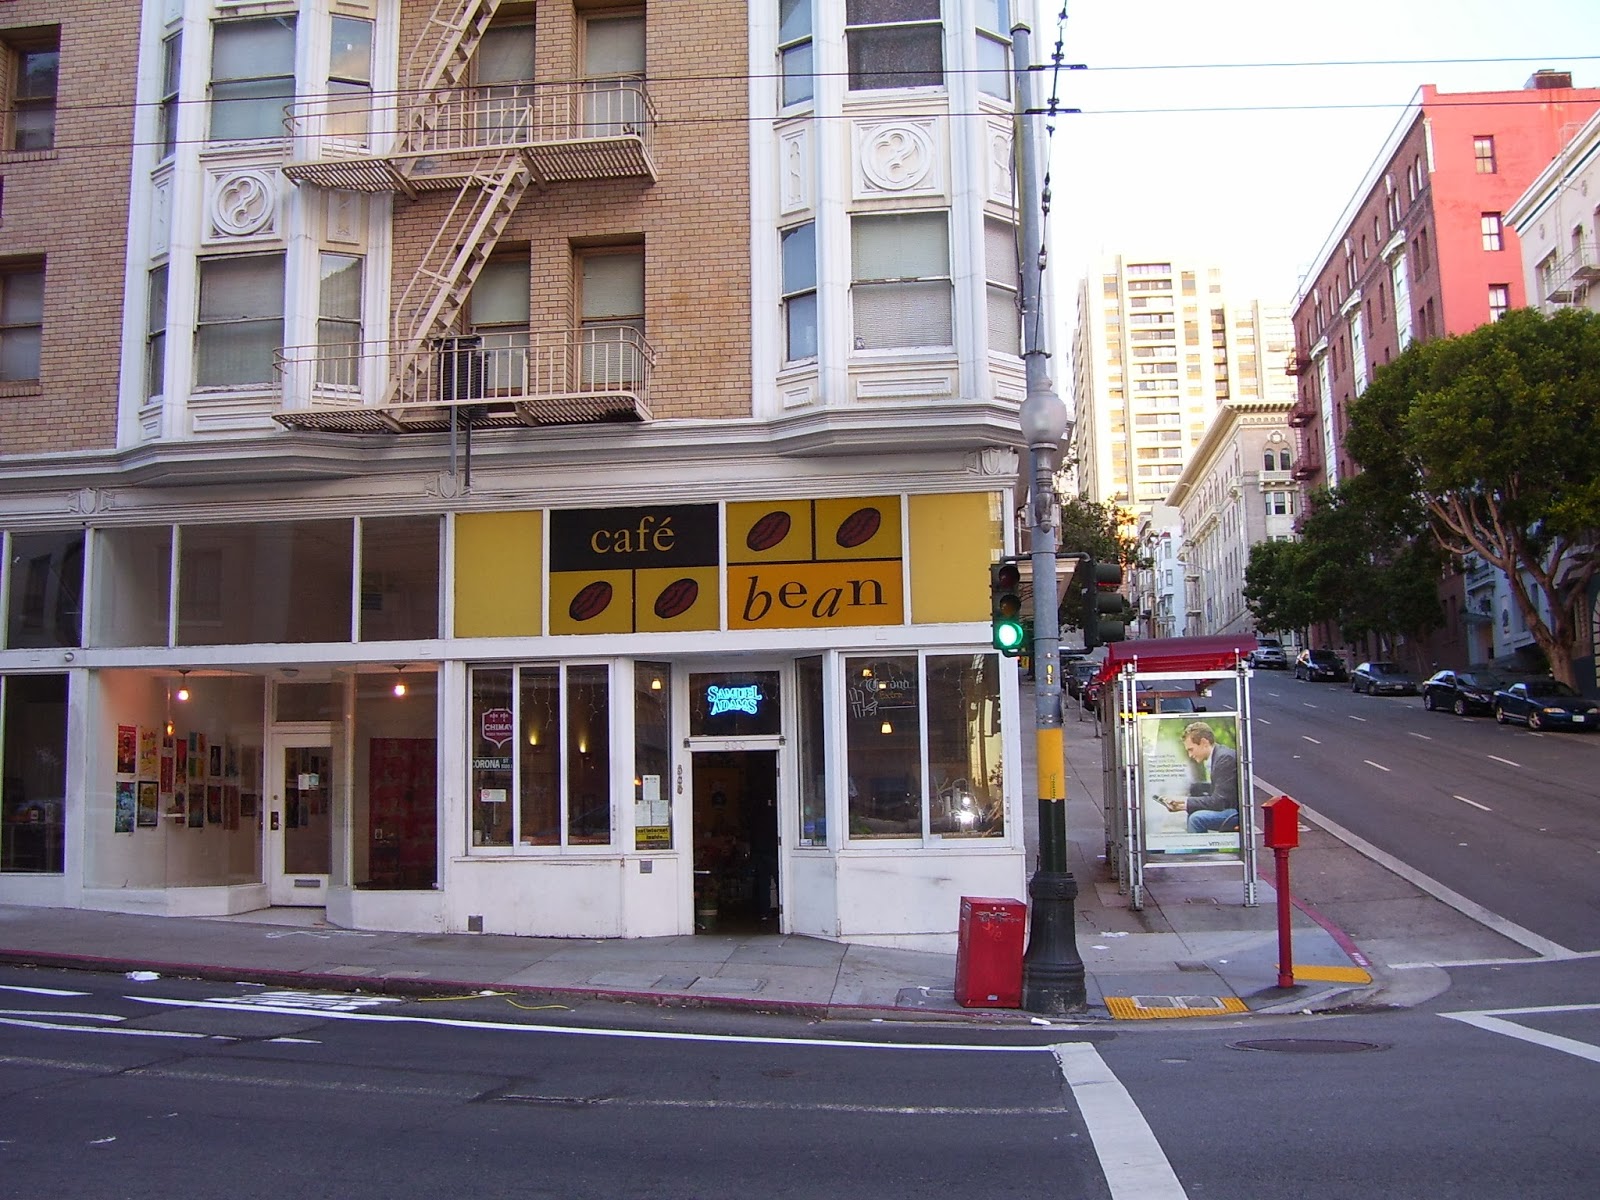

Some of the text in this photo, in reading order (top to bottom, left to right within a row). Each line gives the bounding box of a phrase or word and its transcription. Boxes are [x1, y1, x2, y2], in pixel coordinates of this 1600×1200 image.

[590, 516, 675, 553] café
[742, 575, 888, 621] bean
[708, 685, 762, 702] SAMUEL
[866, 678, 910, 692] Cona
[711, 699, 757, 715] ADAMS
